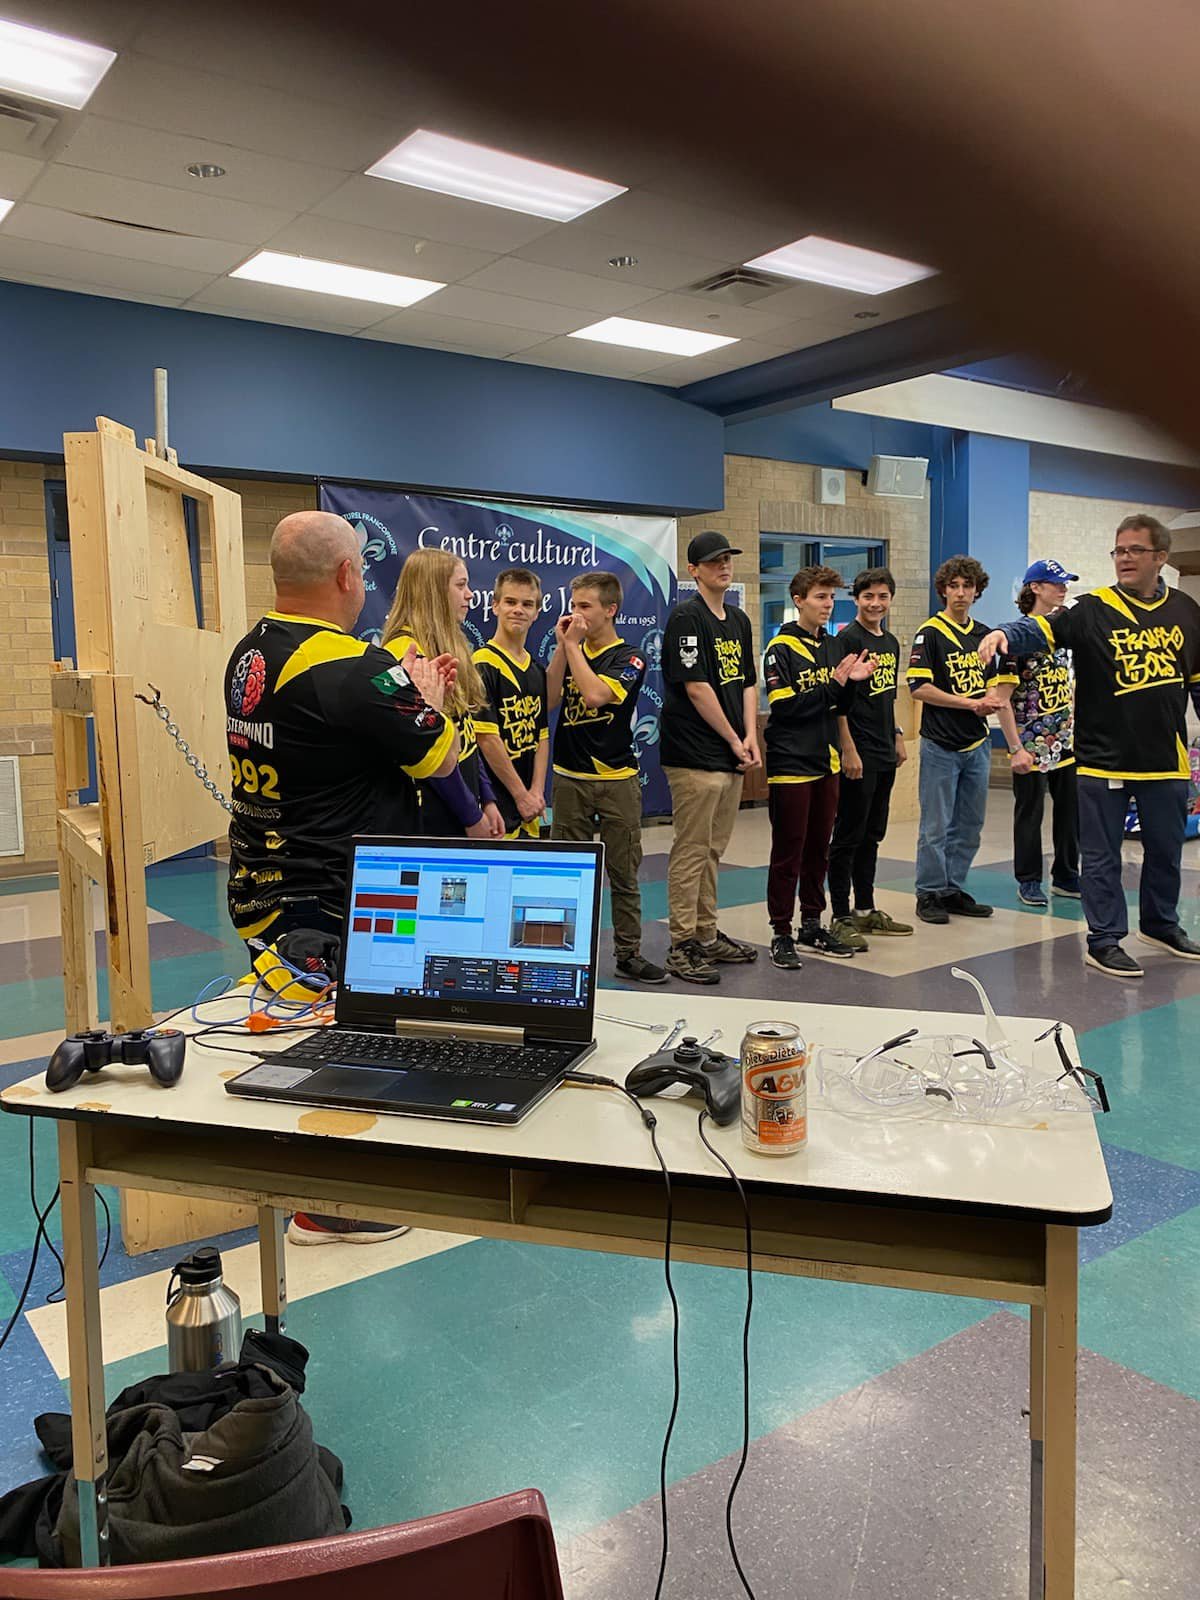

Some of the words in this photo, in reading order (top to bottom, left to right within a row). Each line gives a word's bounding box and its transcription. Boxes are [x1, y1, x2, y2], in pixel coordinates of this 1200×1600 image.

[362, 512, 398, 555] FRANCOPHONE
[417, 526, 500, 562] Centre
[508, 528, 600, 567] culturel
[627, 616, 638, 625] en
[639, 615, 657, 627] 1958
[1108, 625, 1184, 660] FRANCO
[227, 716, 274, 750] STERMIND
[768, 1047, 797, 1061] Diète
